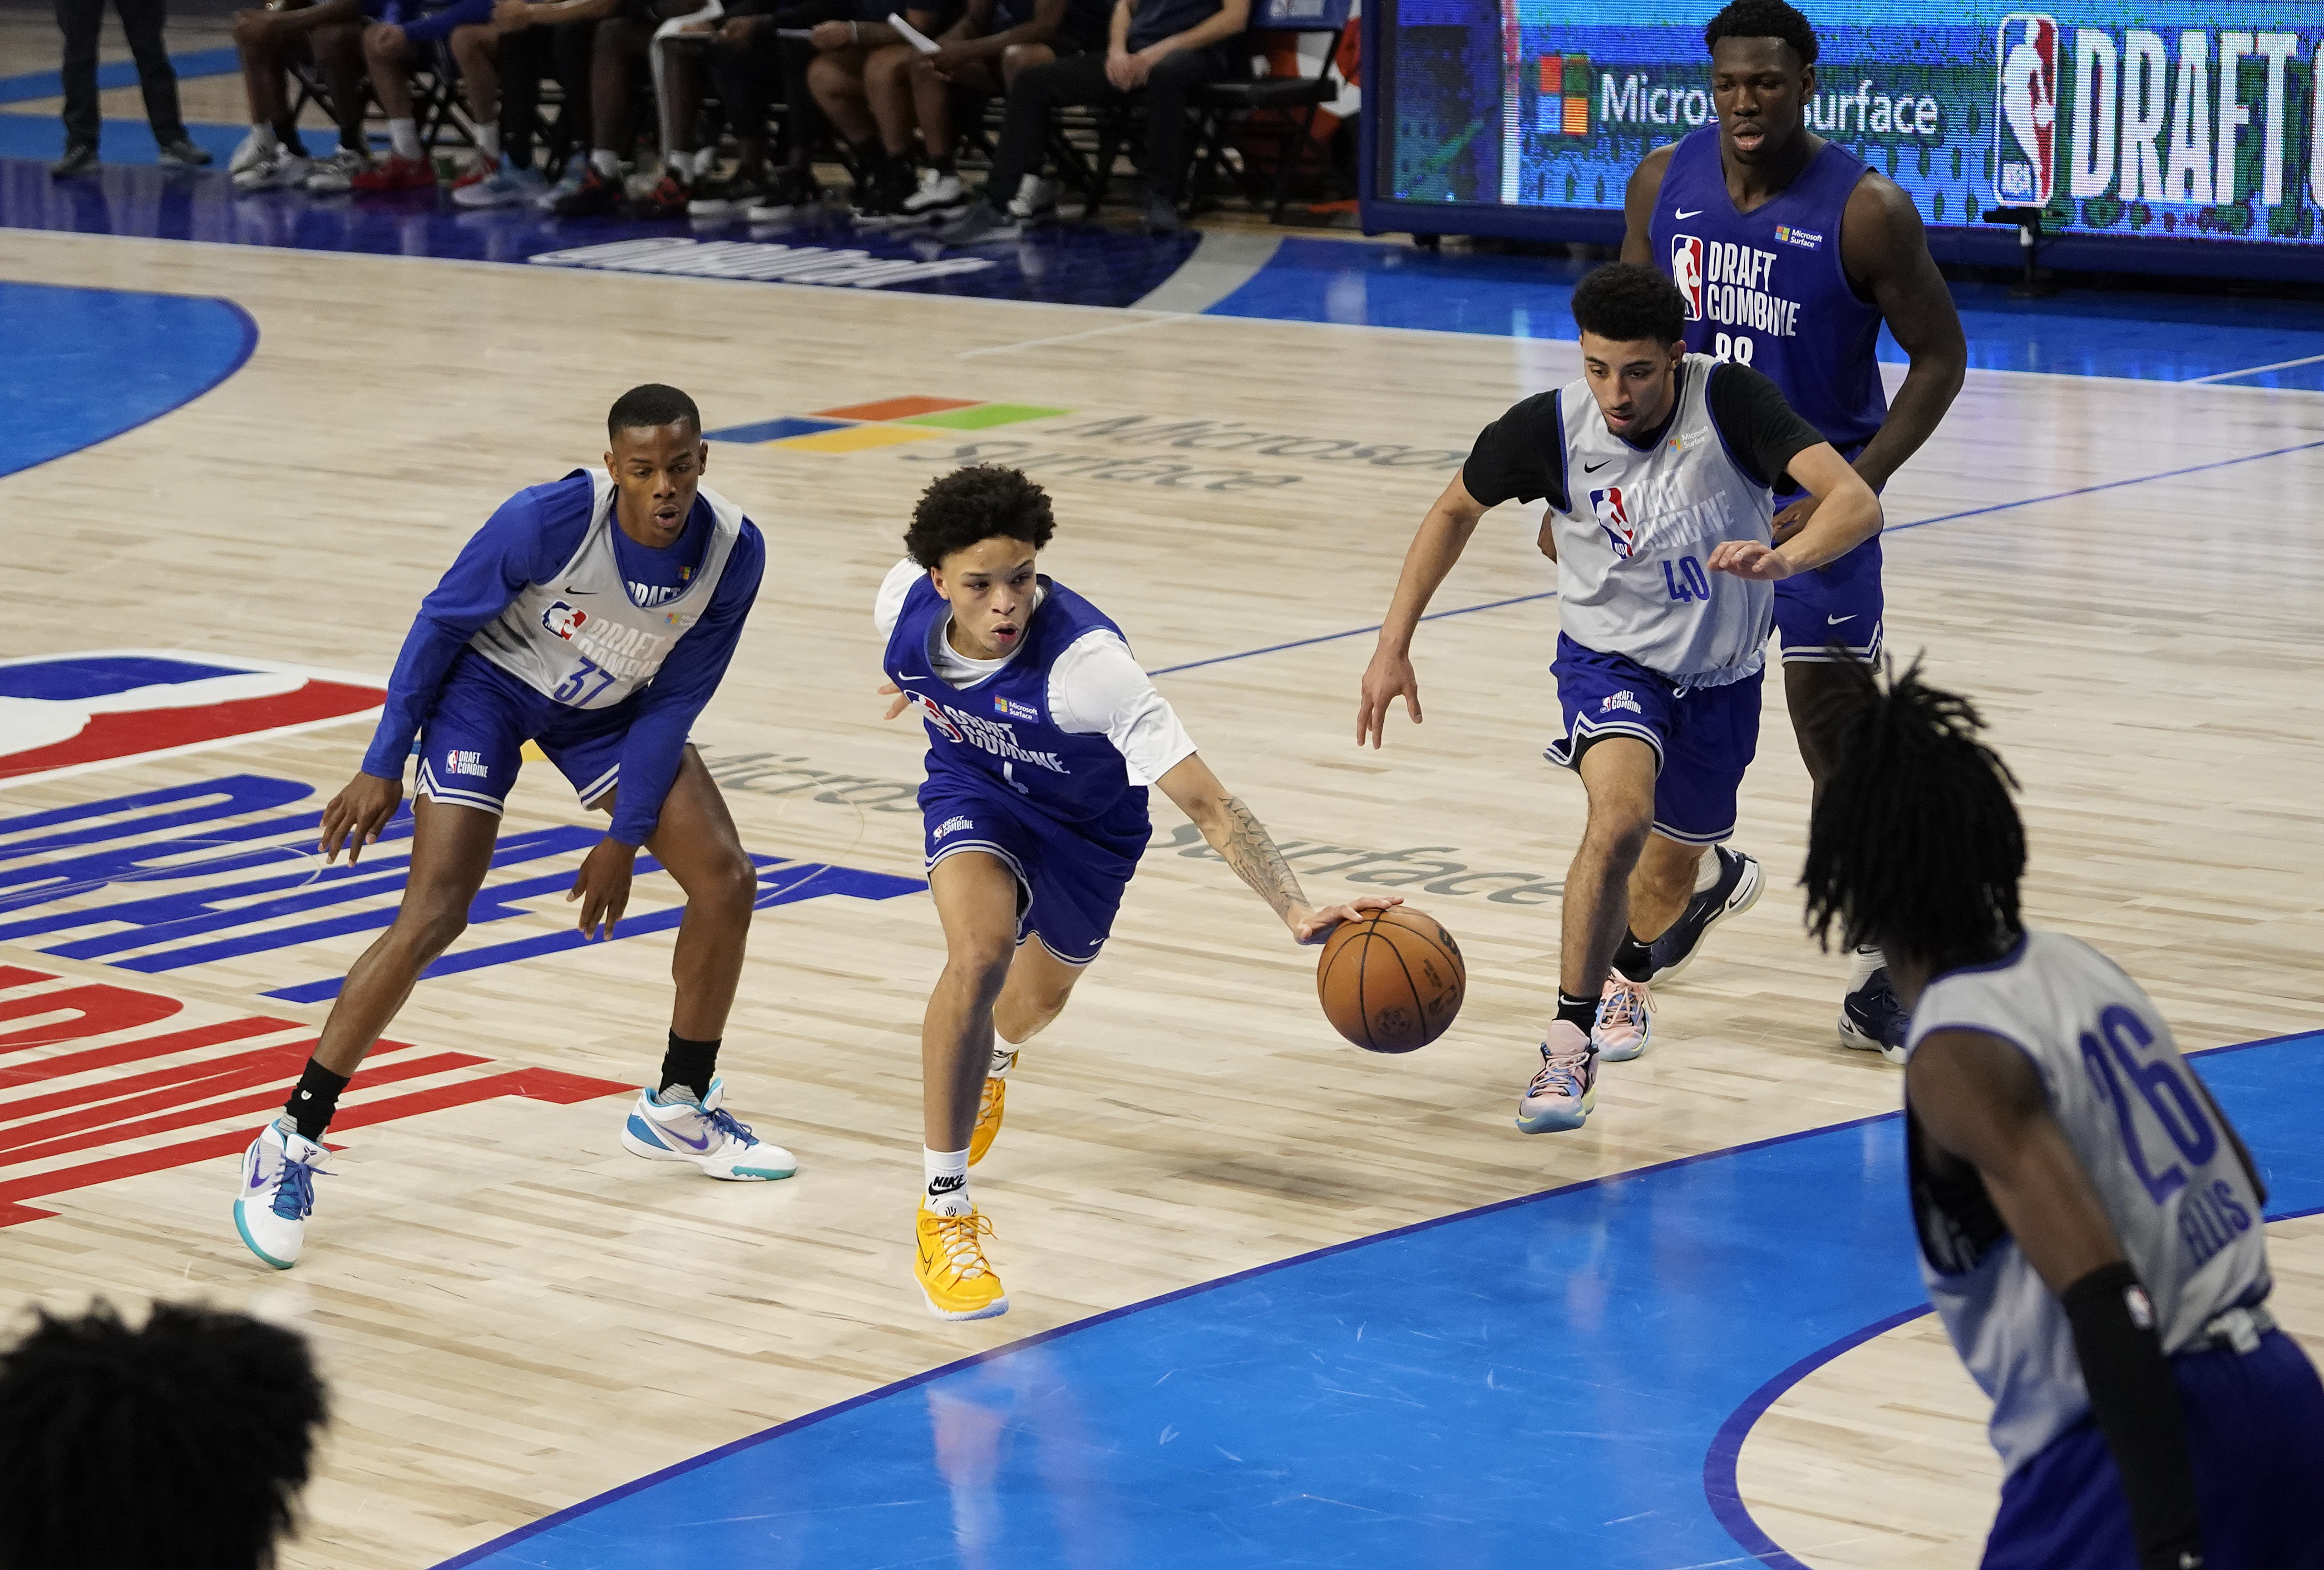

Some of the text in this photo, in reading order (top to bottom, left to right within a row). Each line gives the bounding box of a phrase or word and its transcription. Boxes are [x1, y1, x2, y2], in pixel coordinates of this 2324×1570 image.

[2070, 28, 2298, 206] DRAFT
[1790, 236, 1815, 248] Surface
[1792, 229, 1823, 243] Microsoft
[1708, 240, 1777, 292] DRAFT
[1707, 283, 1801, 337] COMBINE
[1663, 556, 1711, 602] 40
[585, 618, 666, 660] DRAFT
[554, 657, 616, 707] 37
[1612, 690, 1635, 701] DRAFT
[1009, 701, 1038, 715] Microsoft
[1009, 708, 1033, 720] Surface
[1611, 699, 1642, 715] COMBINE
[943, 704, 1019, 747] DRAFT
[458, 750, 481, 764] DRAFT
[457, 762, 489, 778] COMBINE
[943, 815, 965, 829] DRAFT
[943, 819, 974, 837] COMBINE
[2079, 1004, 2219, 1207] 26
[932, 1173, 965, 1188] NIKE
